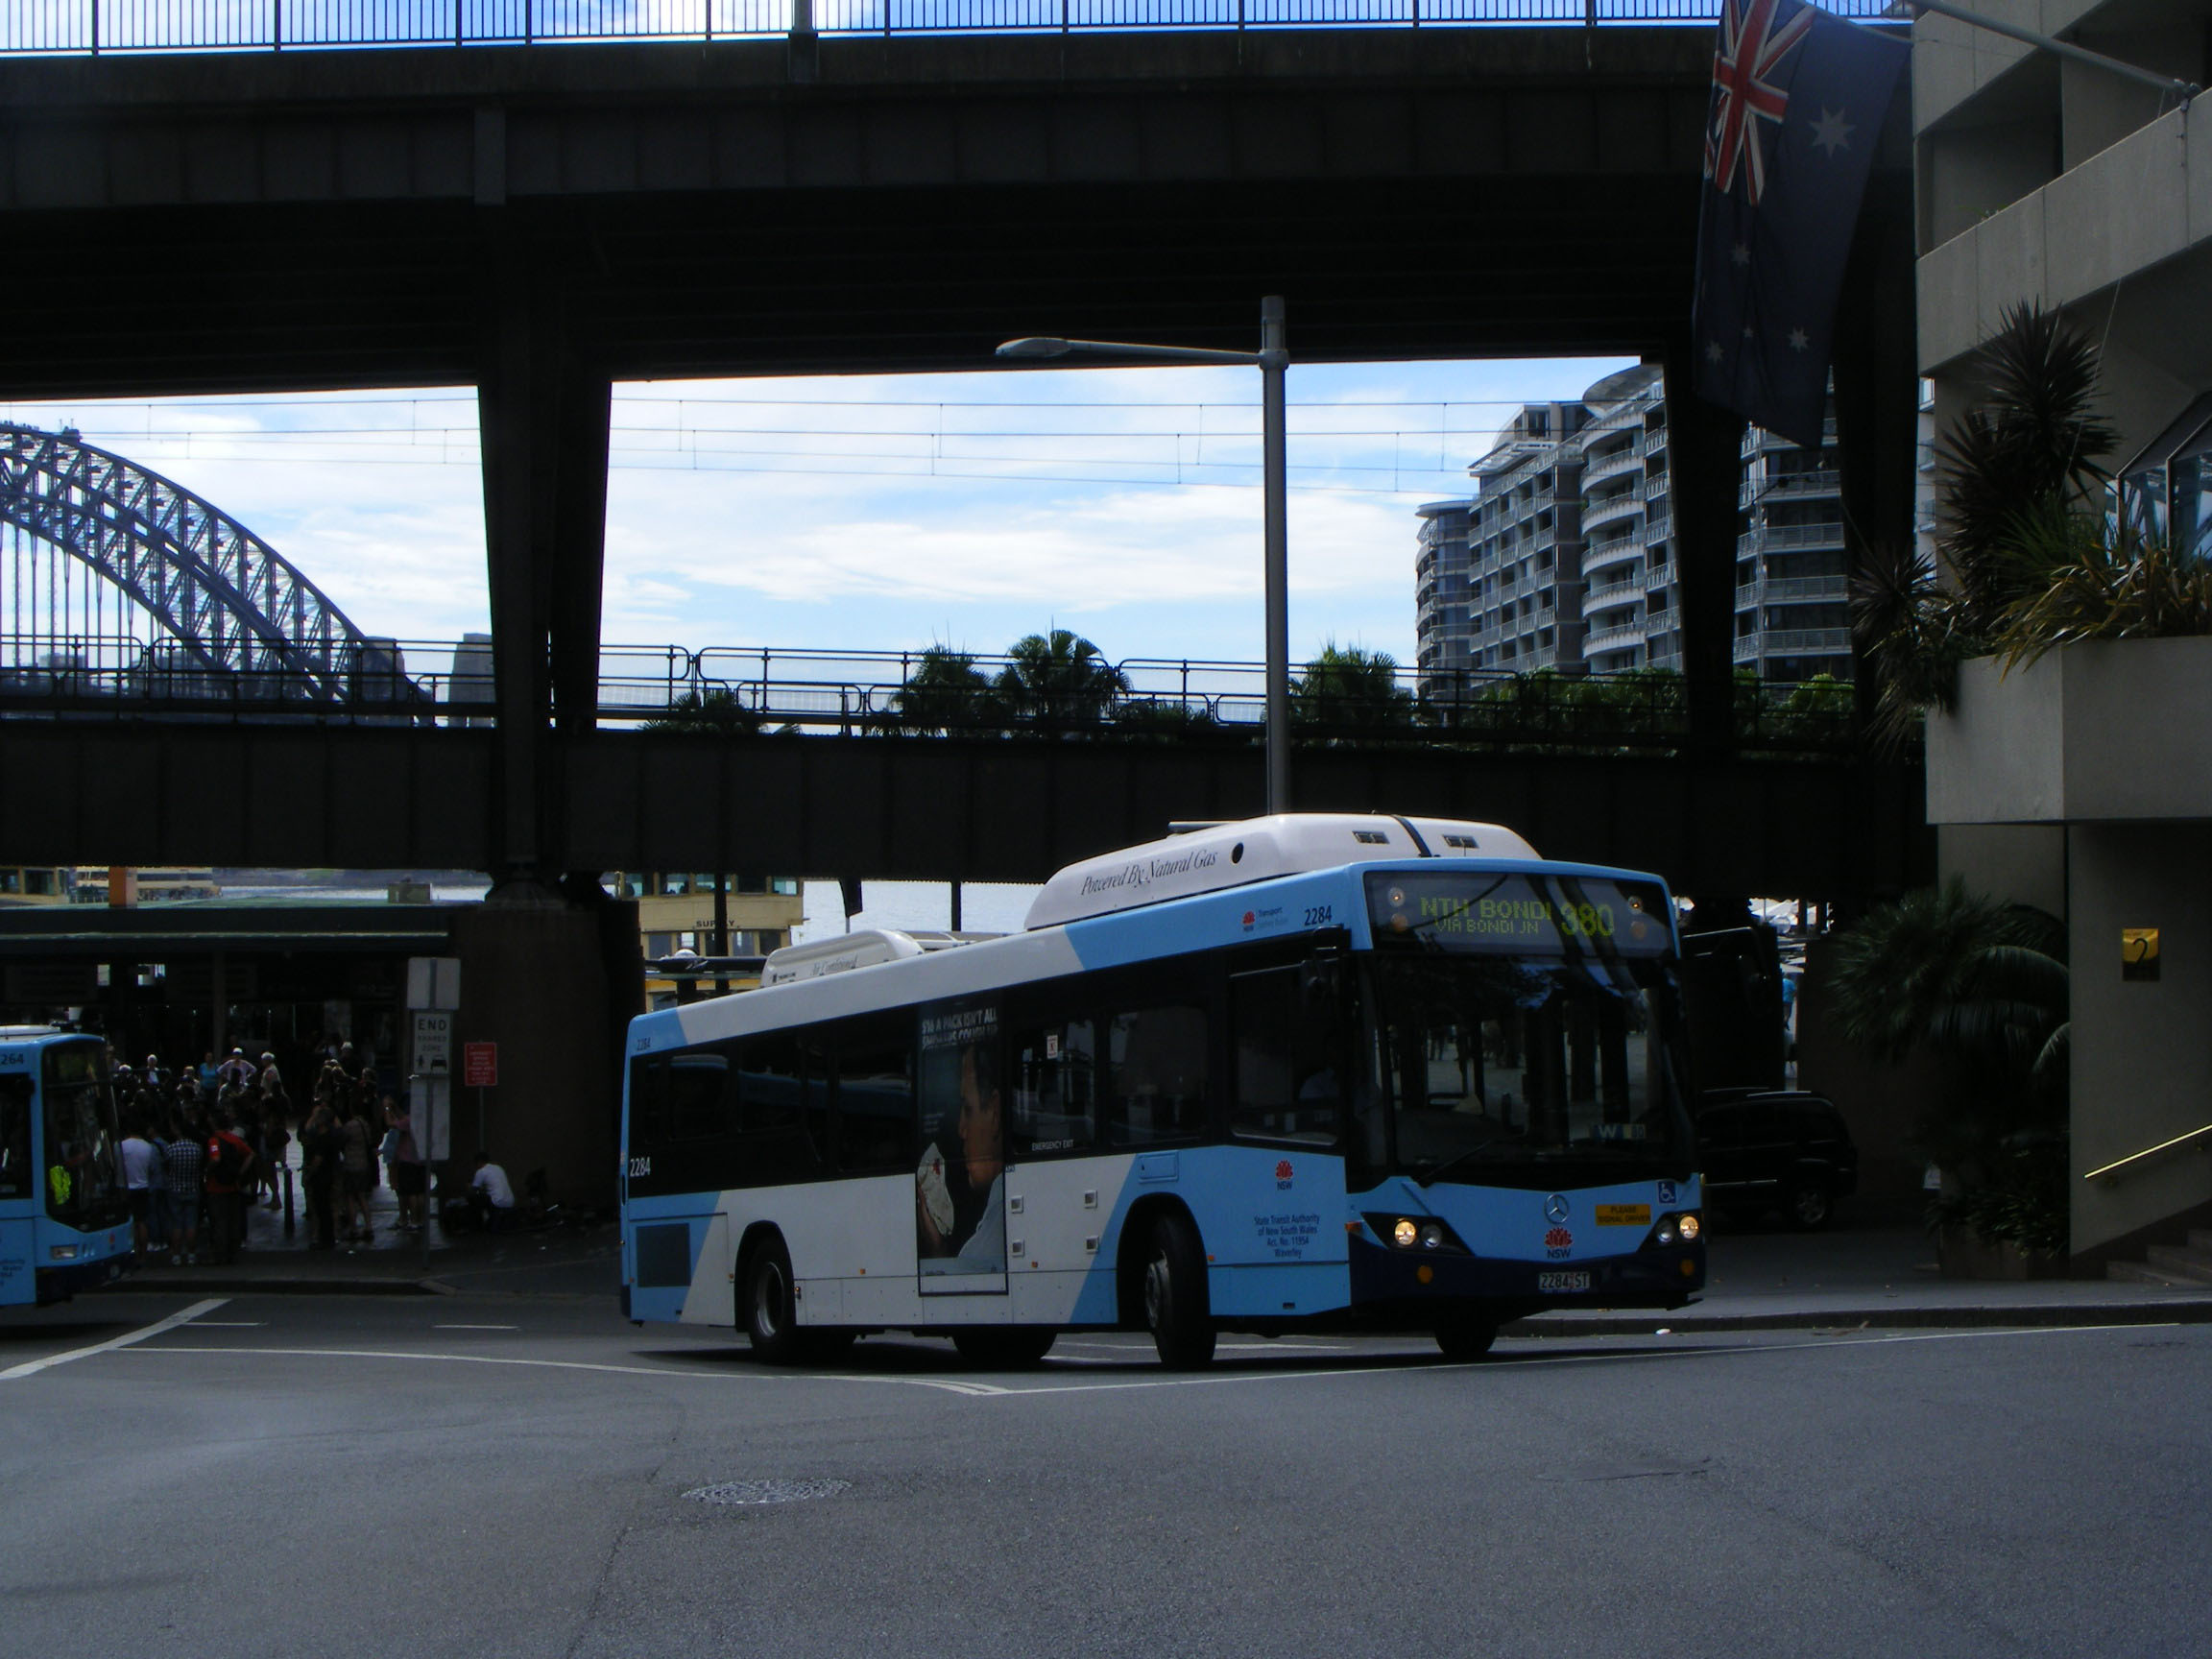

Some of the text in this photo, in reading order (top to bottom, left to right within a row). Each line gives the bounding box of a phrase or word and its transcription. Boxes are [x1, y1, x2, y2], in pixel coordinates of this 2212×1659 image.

[1081, 850, 1217, 895] Powered By Natural Gas
[1305, 904, 1332, 926] 2284
[1420, 897, 1551, 921] NTH BONDI
[1434, 918, 1540, 935] VIA BONDI JN
[1560, 902, 1615, 937] 380
[983, 1006, 998, 1024] ALL
[418, 1019, 446, 1030] END
[629, 1156, 651, 1177] 2284
[1277, 1181, 1292, 1190] NSW
[1291, 1214, 1320, 1225] Authority
[1548, 1250, 1572, 1260] NSW
[1541, 1273, 1588, 1288] 2284 ST
